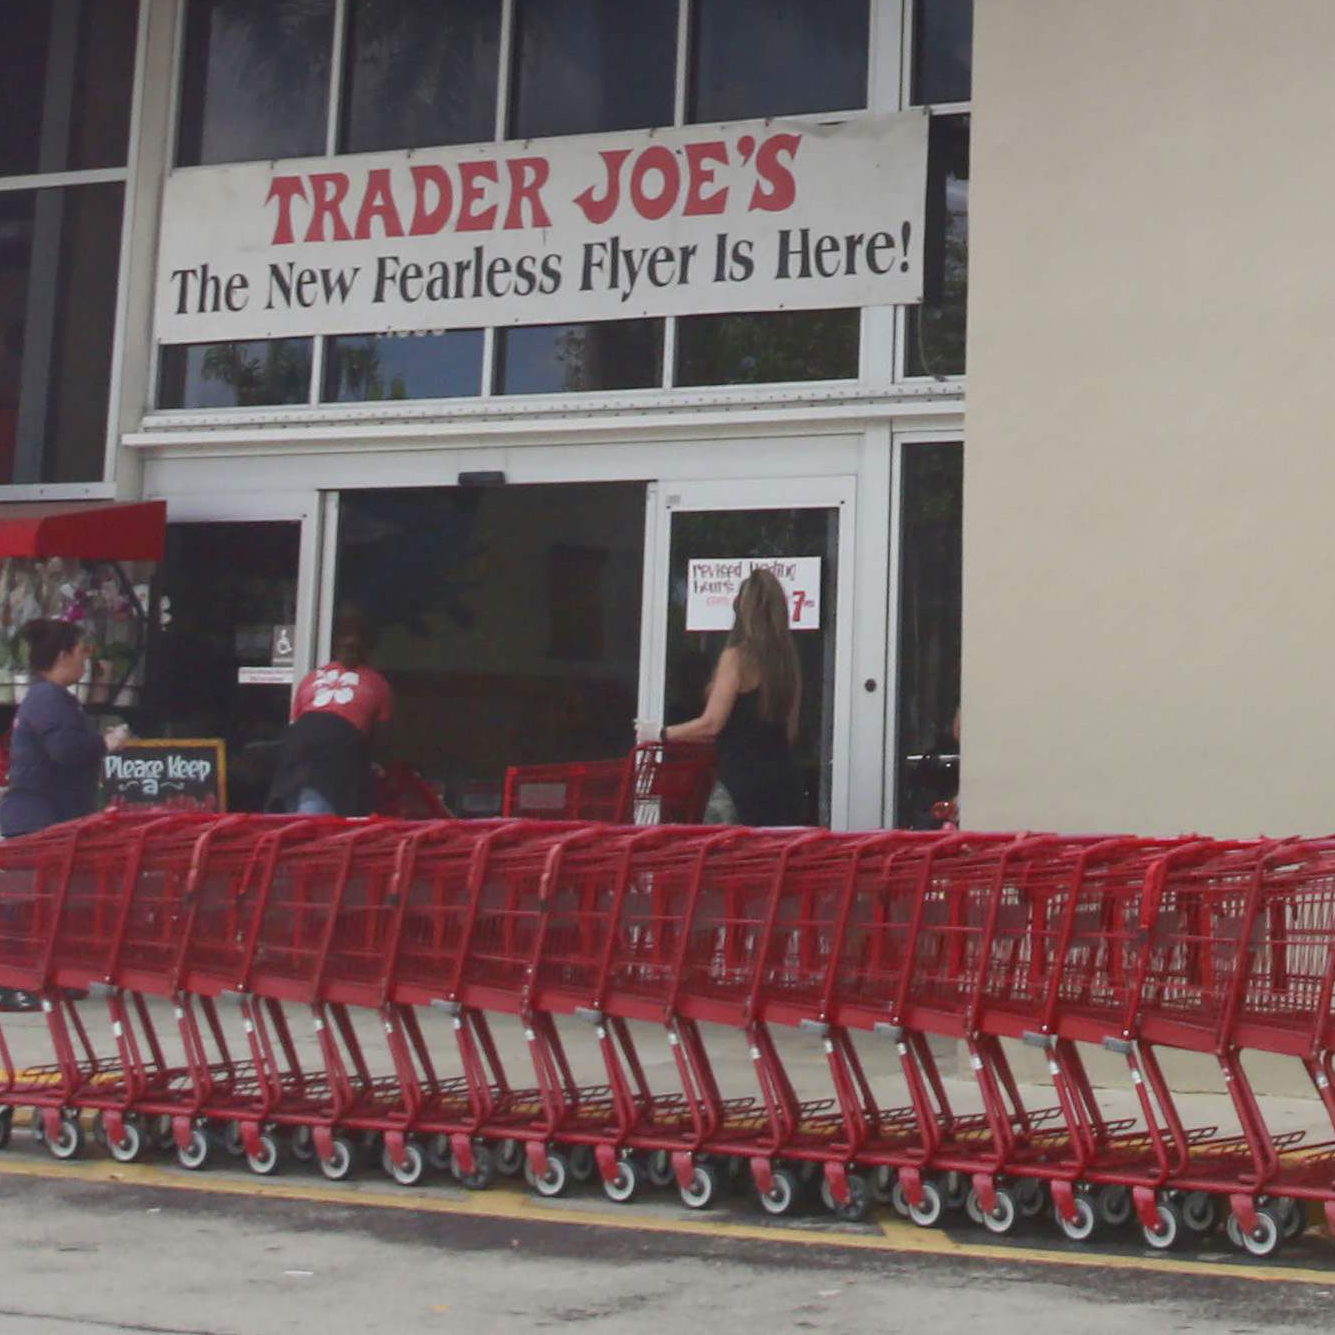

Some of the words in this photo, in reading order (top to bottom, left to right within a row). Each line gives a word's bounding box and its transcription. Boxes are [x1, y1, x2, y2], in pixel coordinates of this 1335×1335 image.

[264, 156, 552, 246] TRADER
[572, 132, 803, 225] JOE'S
[171, 267, 249, 315] The
[265, 260, 359, 310] New
[371, 244, 563, 305] Fearless
[579, 236, 698, 303] Flyer
[712, 232, 755, 282] Is
[775, 220, 913, 279] Here!
[104, 754, 164, 780] Please
[167, 754, 212, 783] Keep
[140, 777, 158, 796] a
